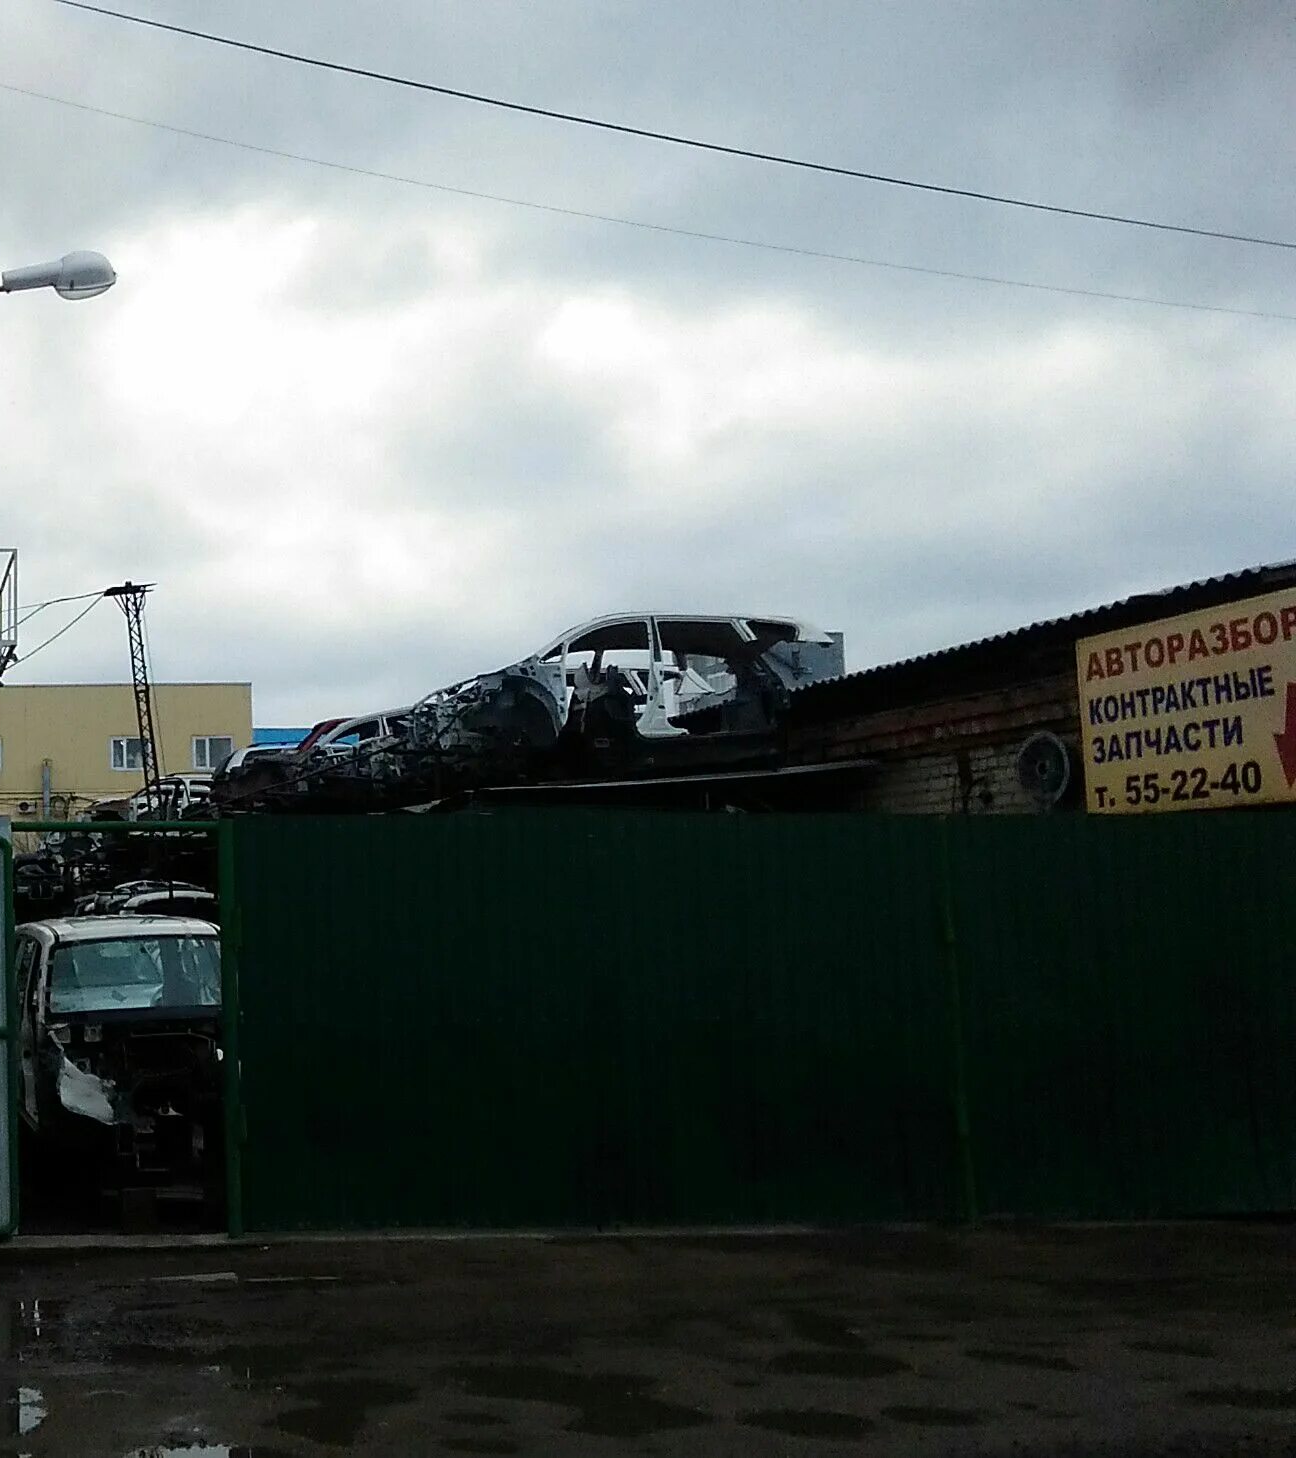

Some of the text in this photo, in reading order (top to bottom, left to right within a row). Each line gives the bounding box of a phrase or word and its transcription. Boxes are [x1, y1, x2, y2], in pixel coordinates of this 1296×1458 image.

[1086, 606, 1296, 682] АВТОРАЗБОР
[1088, 665, 1275, 726] КОНТРАКТНЫЕ
[1092, 715, 1244, 764] ЗАПЧАСТИ
[1125, 761, 1262, 805] 55-22-40
